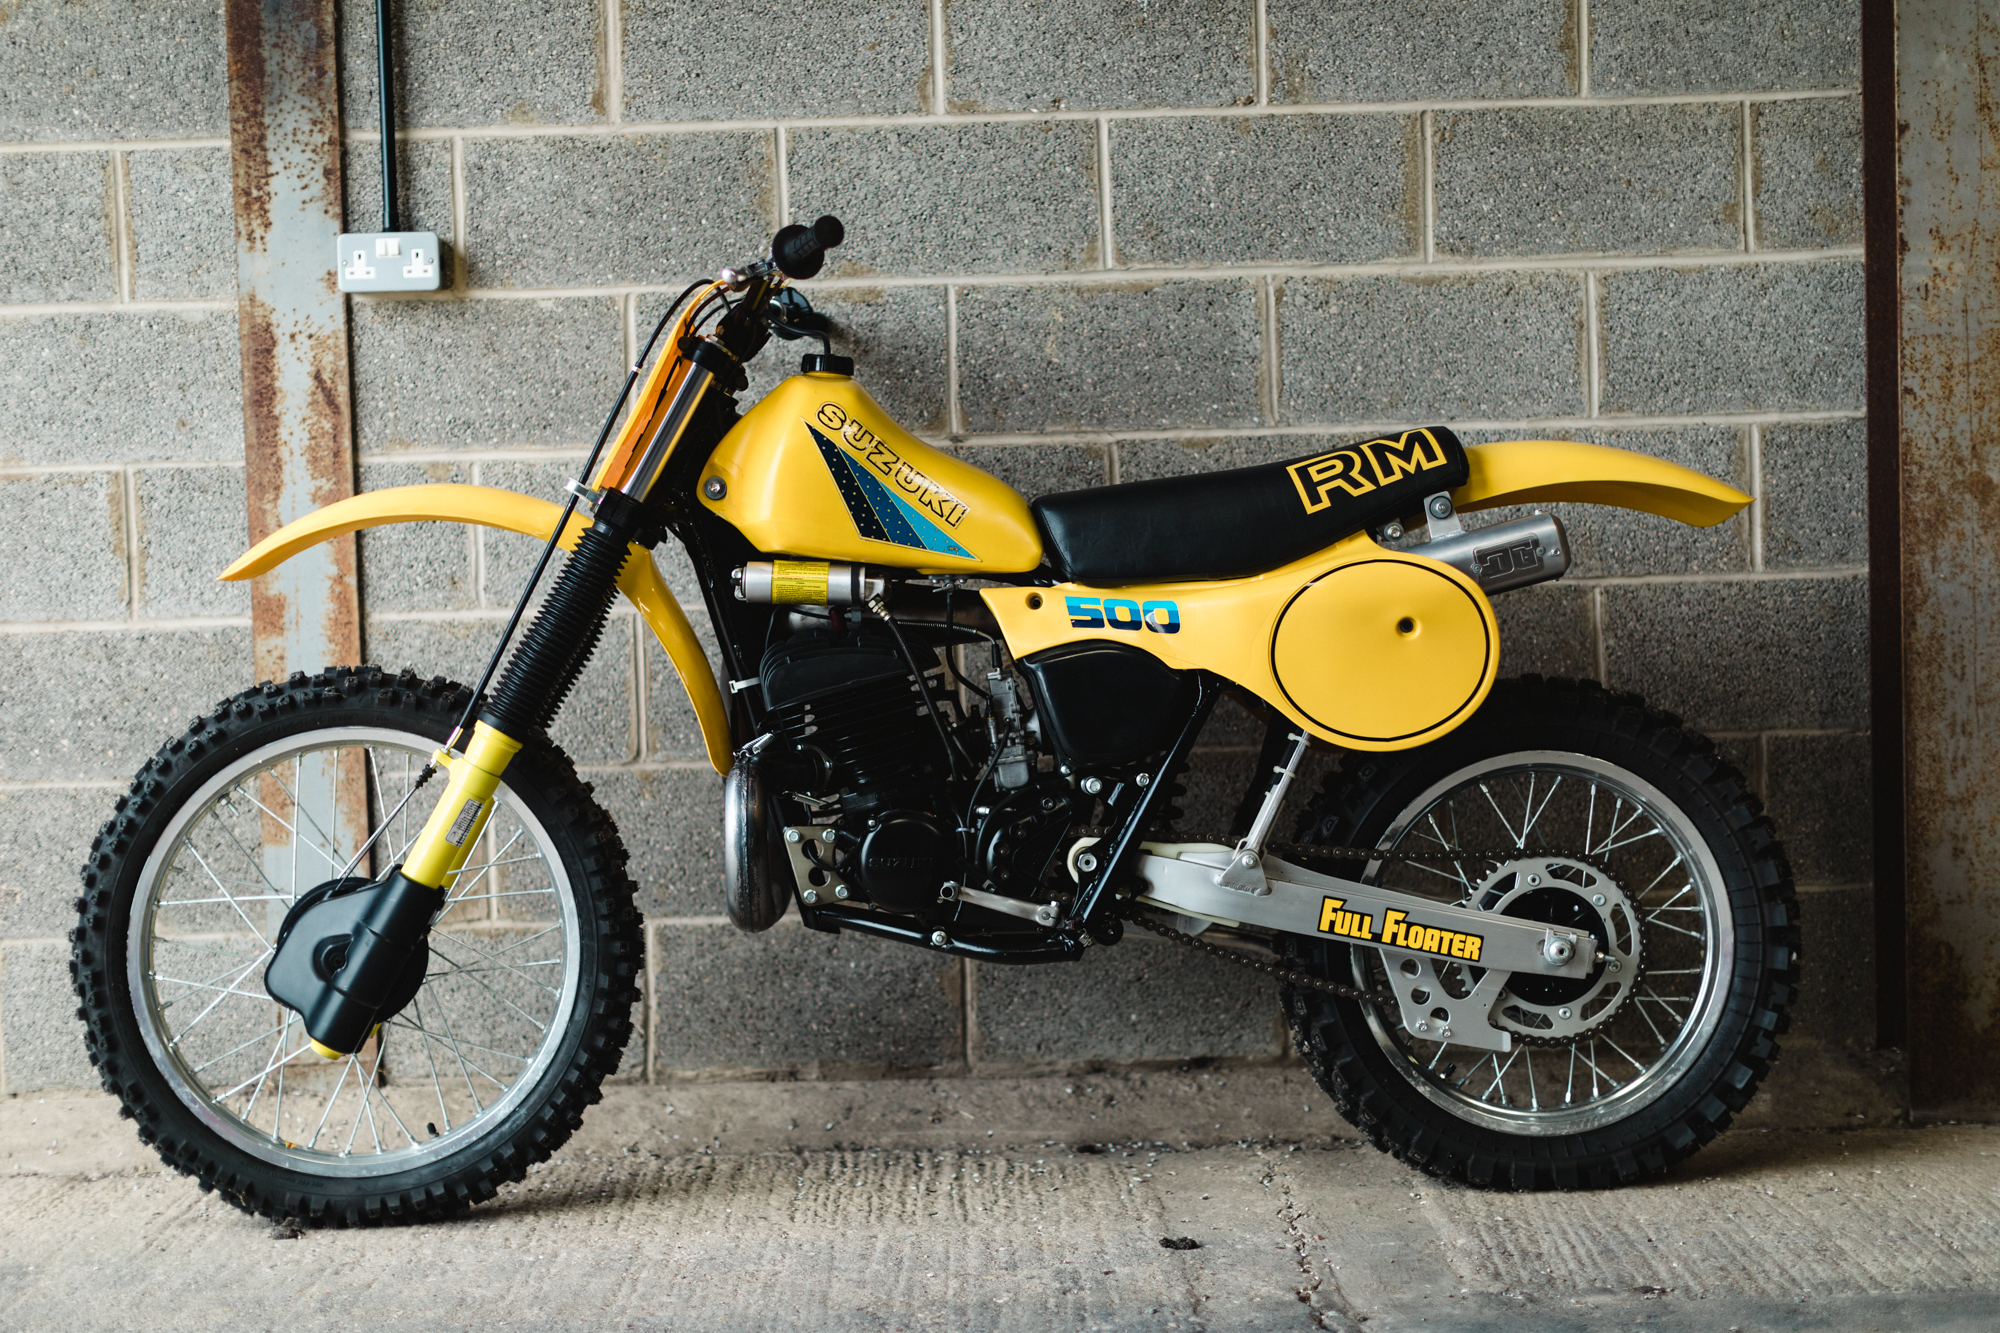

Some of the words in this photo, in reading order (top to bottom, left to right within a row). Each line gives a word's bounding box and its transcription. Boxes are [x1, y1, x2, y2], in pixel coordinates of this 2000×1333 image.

[816, 402, 969, 528] SUZUKI
[1286, 427, 1448, 515] RM
[1064, 596, 1181, 634] 500
[1318, 896, 1373, 940] FULL
[1381, 908, 1483, 962] FLOATER
